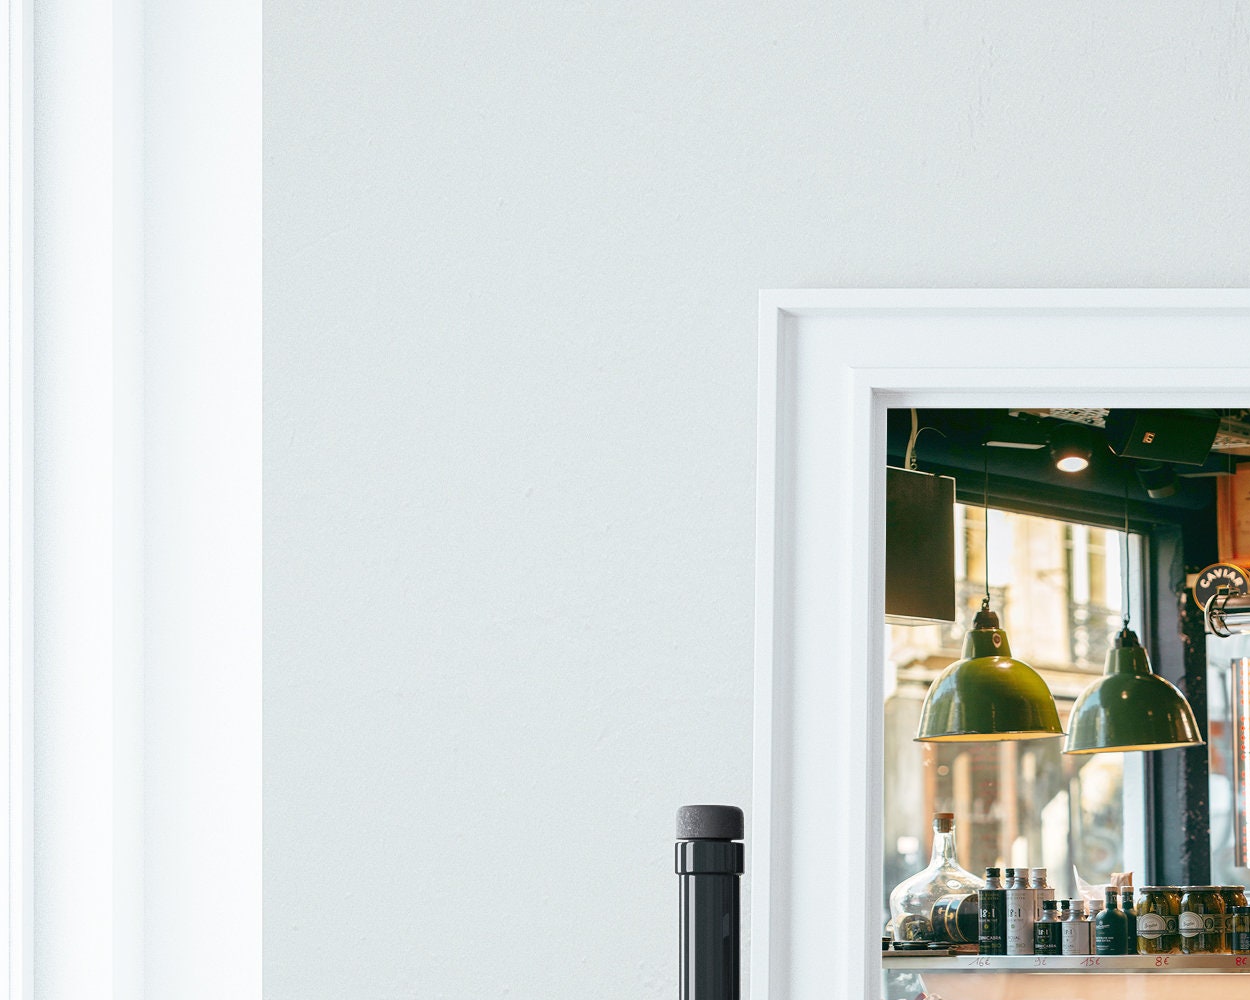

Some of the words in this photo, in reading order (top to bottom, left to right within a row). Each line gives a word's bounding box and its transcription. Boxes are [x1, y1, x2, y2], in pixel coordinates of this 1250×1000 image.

[1200, 568, 1244, 588] CAVIAR
[1155, 957, 1169, 966] 8€
[1235, 957, 1247, 966] 8€
